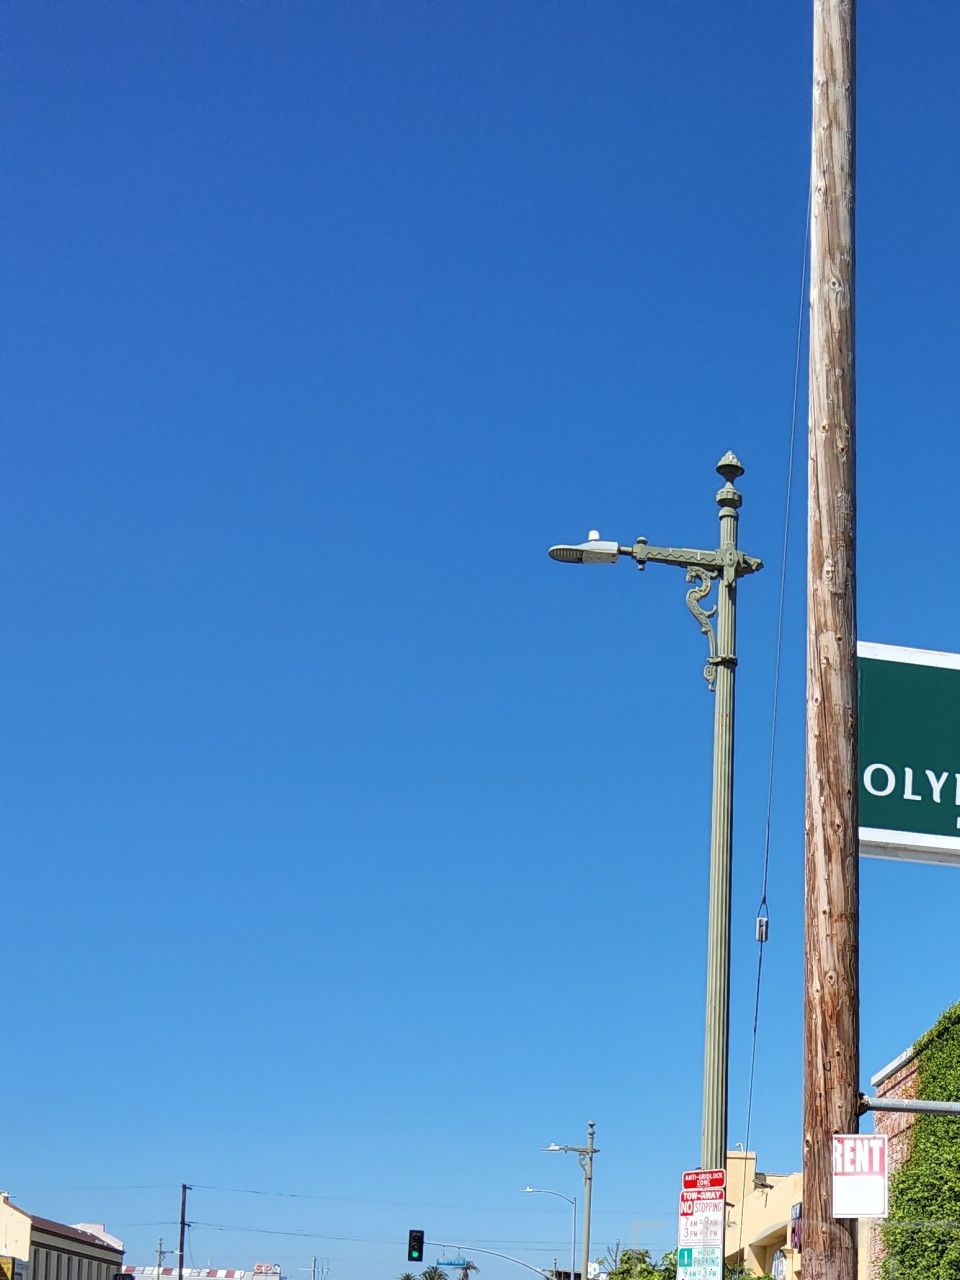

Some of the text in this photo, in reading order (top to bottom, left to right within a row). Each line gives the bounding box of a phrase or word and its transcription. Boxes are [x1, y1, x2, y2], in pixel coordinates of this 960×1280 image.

[683, 1191, 721, 1200] TOW-AWAY
[681, 1201, 722, 1214] NO STOPPING
[698, 1248, 716, 1257] HOUR
[693, 1256, 719, 1268] PARKING
[256, 1264, 282, 1275] SPA
